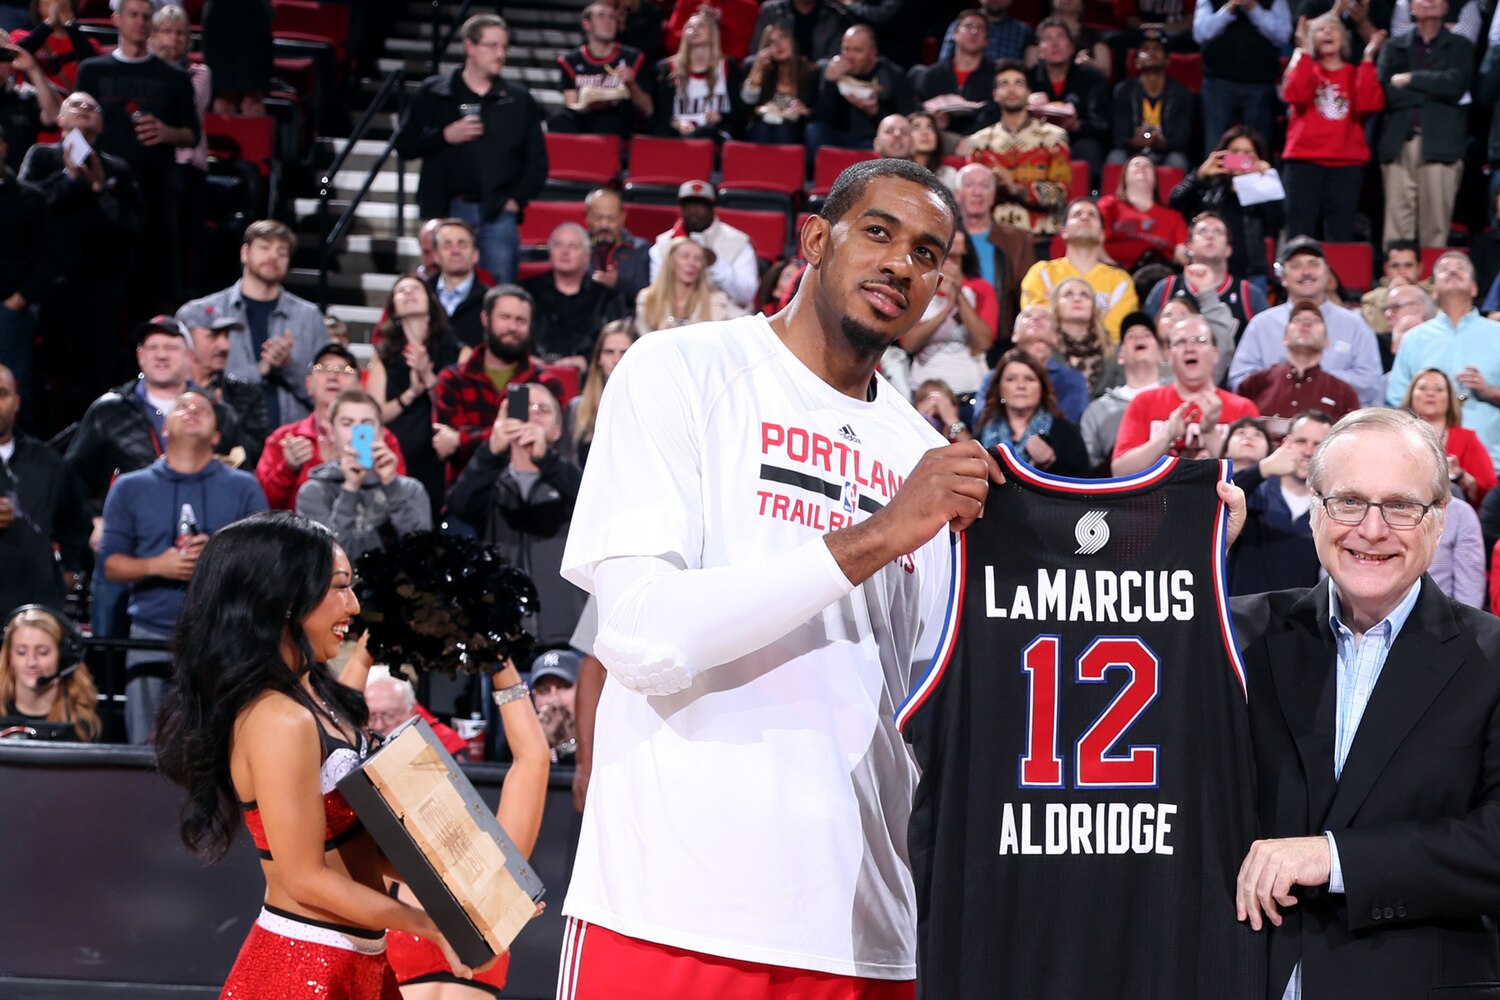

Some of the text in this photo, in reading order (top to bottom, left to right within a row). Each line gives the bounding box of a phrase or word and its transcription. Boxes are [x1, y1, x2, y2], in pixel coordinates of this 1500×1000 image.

[761, 421, 906, 500] PORTLAN
[1018, 633, 1162, 789] 12
[999, 802, 1178, 856] ALDRIDGE
